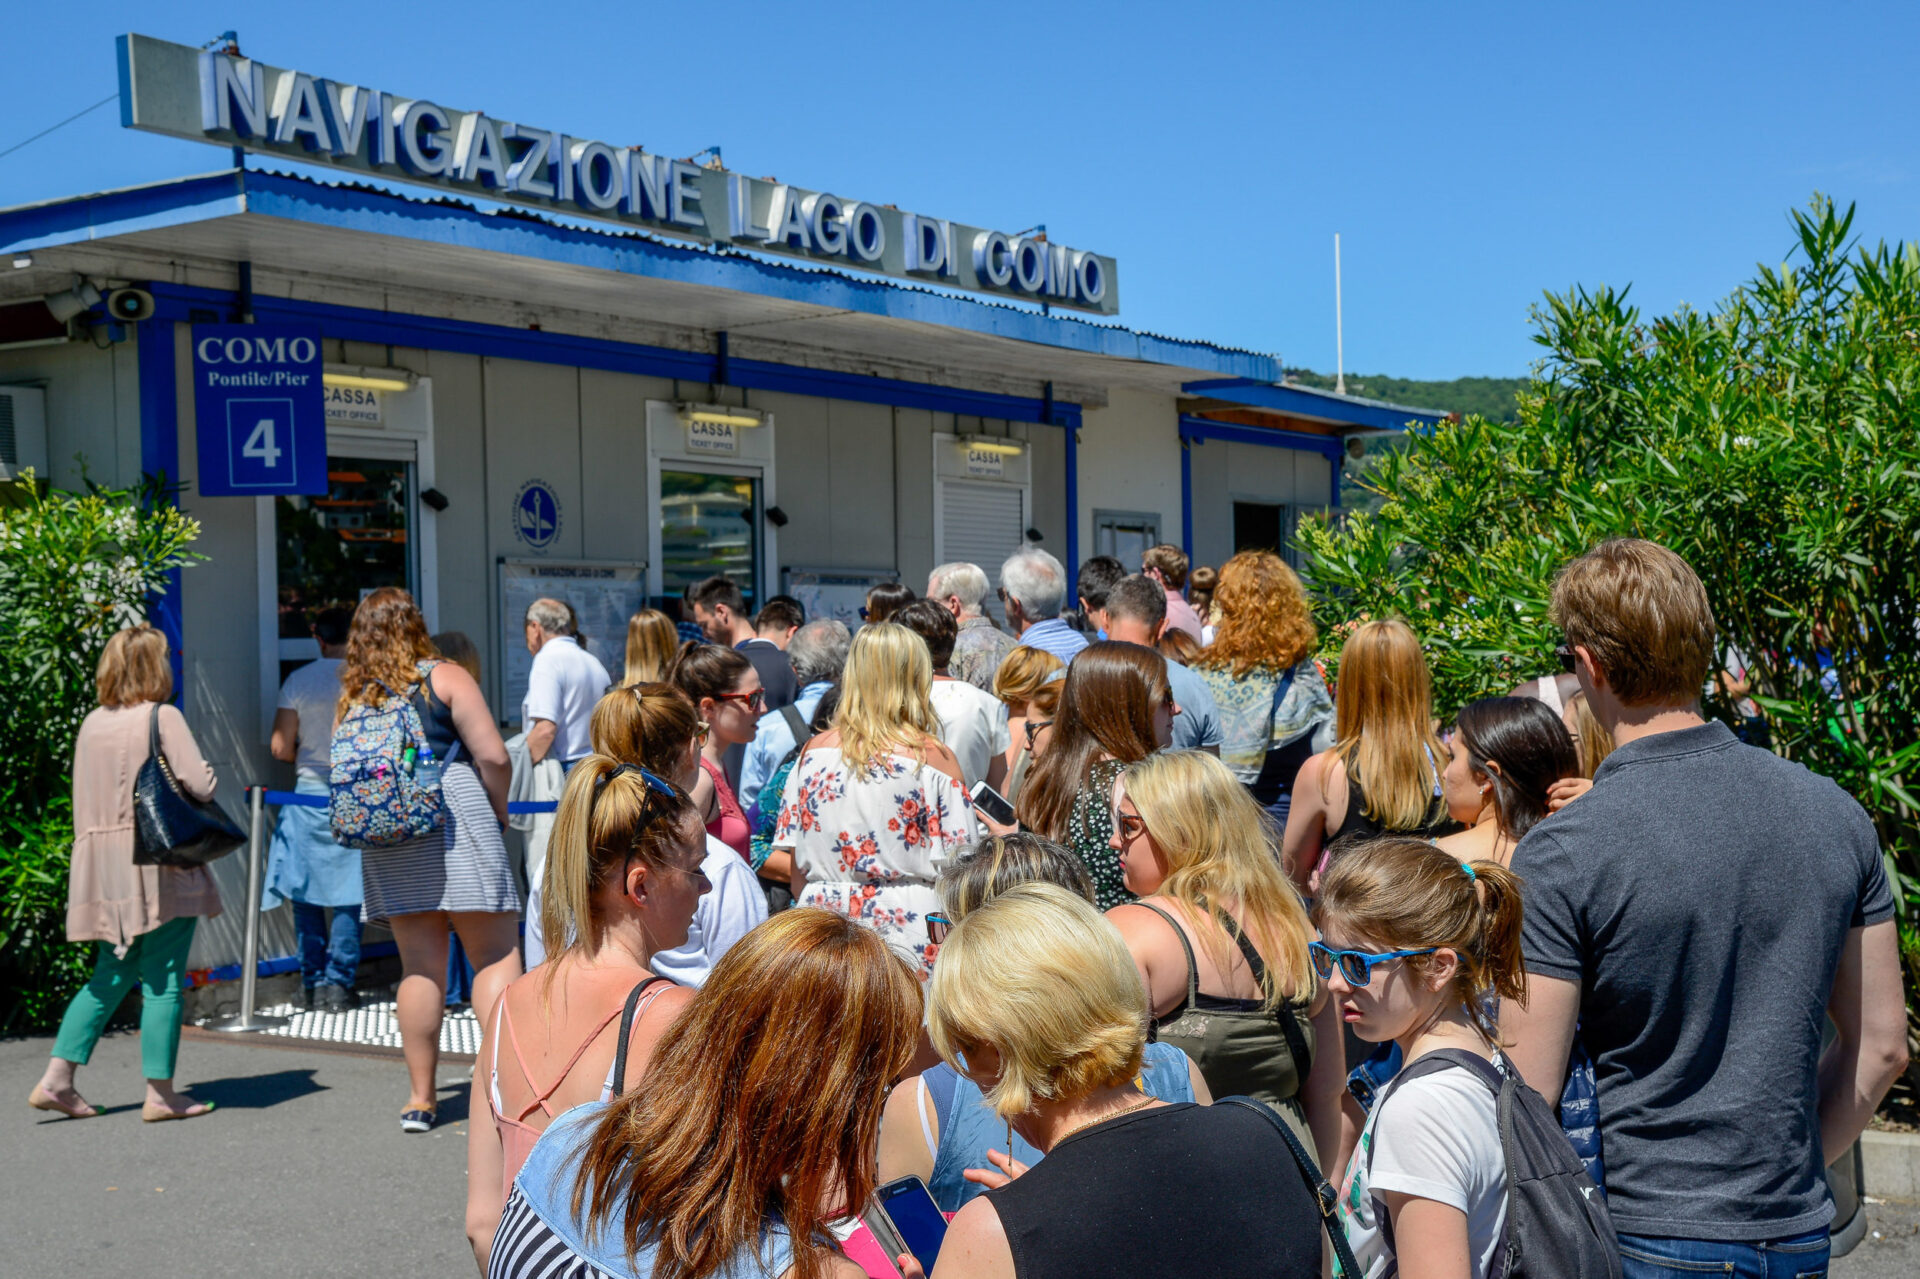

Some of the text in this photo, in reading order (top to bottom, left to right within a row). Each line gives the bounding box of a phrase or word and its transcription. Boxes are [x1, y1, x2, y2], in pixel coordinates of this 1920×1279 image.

[201, 51, 1107, 303] NAVIGAZIONE LAGO DI COMO
[198, 337, 316, 364] COMO
[208, 371, 310, 387] Pontile/Pier
[326, 408, 378, 421] CKET OFFICE
[691, 420, 732, 437] CASSA
[242, 419, 281, 468] 4
[691, 439, 733, 450] TICKET OFFICE
[969, 450, 1001, 465] CASSA
